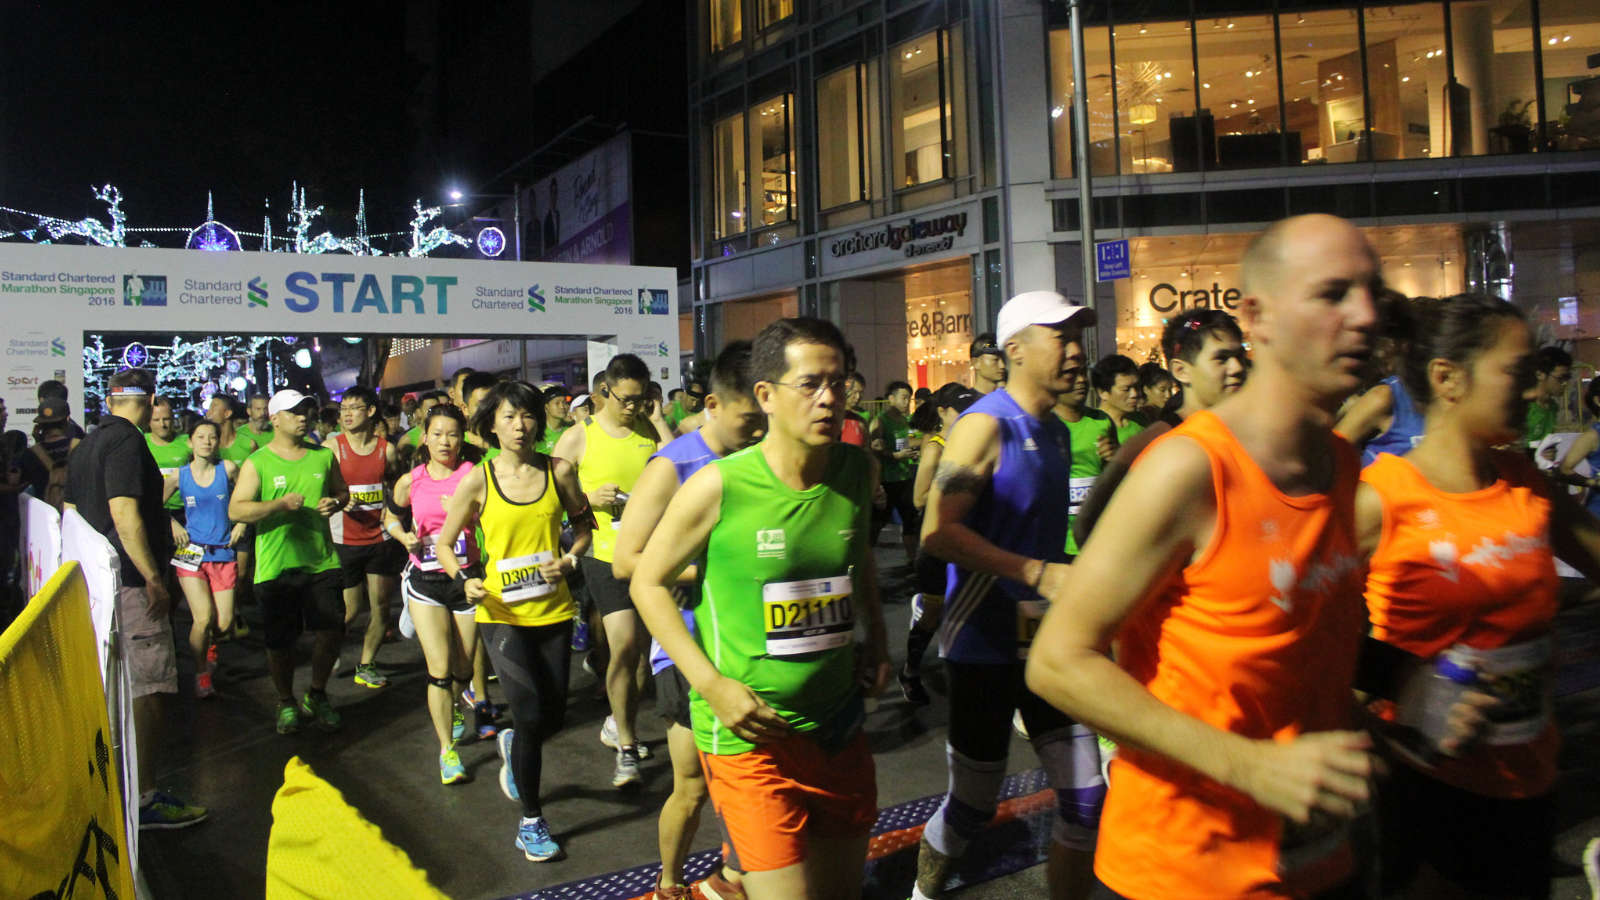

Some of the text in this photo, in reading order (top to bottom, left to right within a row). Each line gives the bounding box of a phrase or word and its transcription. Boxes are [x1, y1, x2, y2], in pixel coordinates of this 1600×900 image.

[1, 271, 116, 283] Standard Chartered
[1, 283, 116, 296] Marathon Singapore
[184, 279, 242, 292] Standard
[554, 285, 633, 296] Standard Chartered
[284, 271, 458, 315] START
[475, 286, 524, 298] Standard
[1149, 282, 1242, 313] Crate
[87, 296, 116, 306] 2016
[179, 292, 242, 306] Chartered
[471, 298, 524, 310] Chartered
[613, 306, 633, 315] 2016
[907, 310, 973, 338] e&Barr
